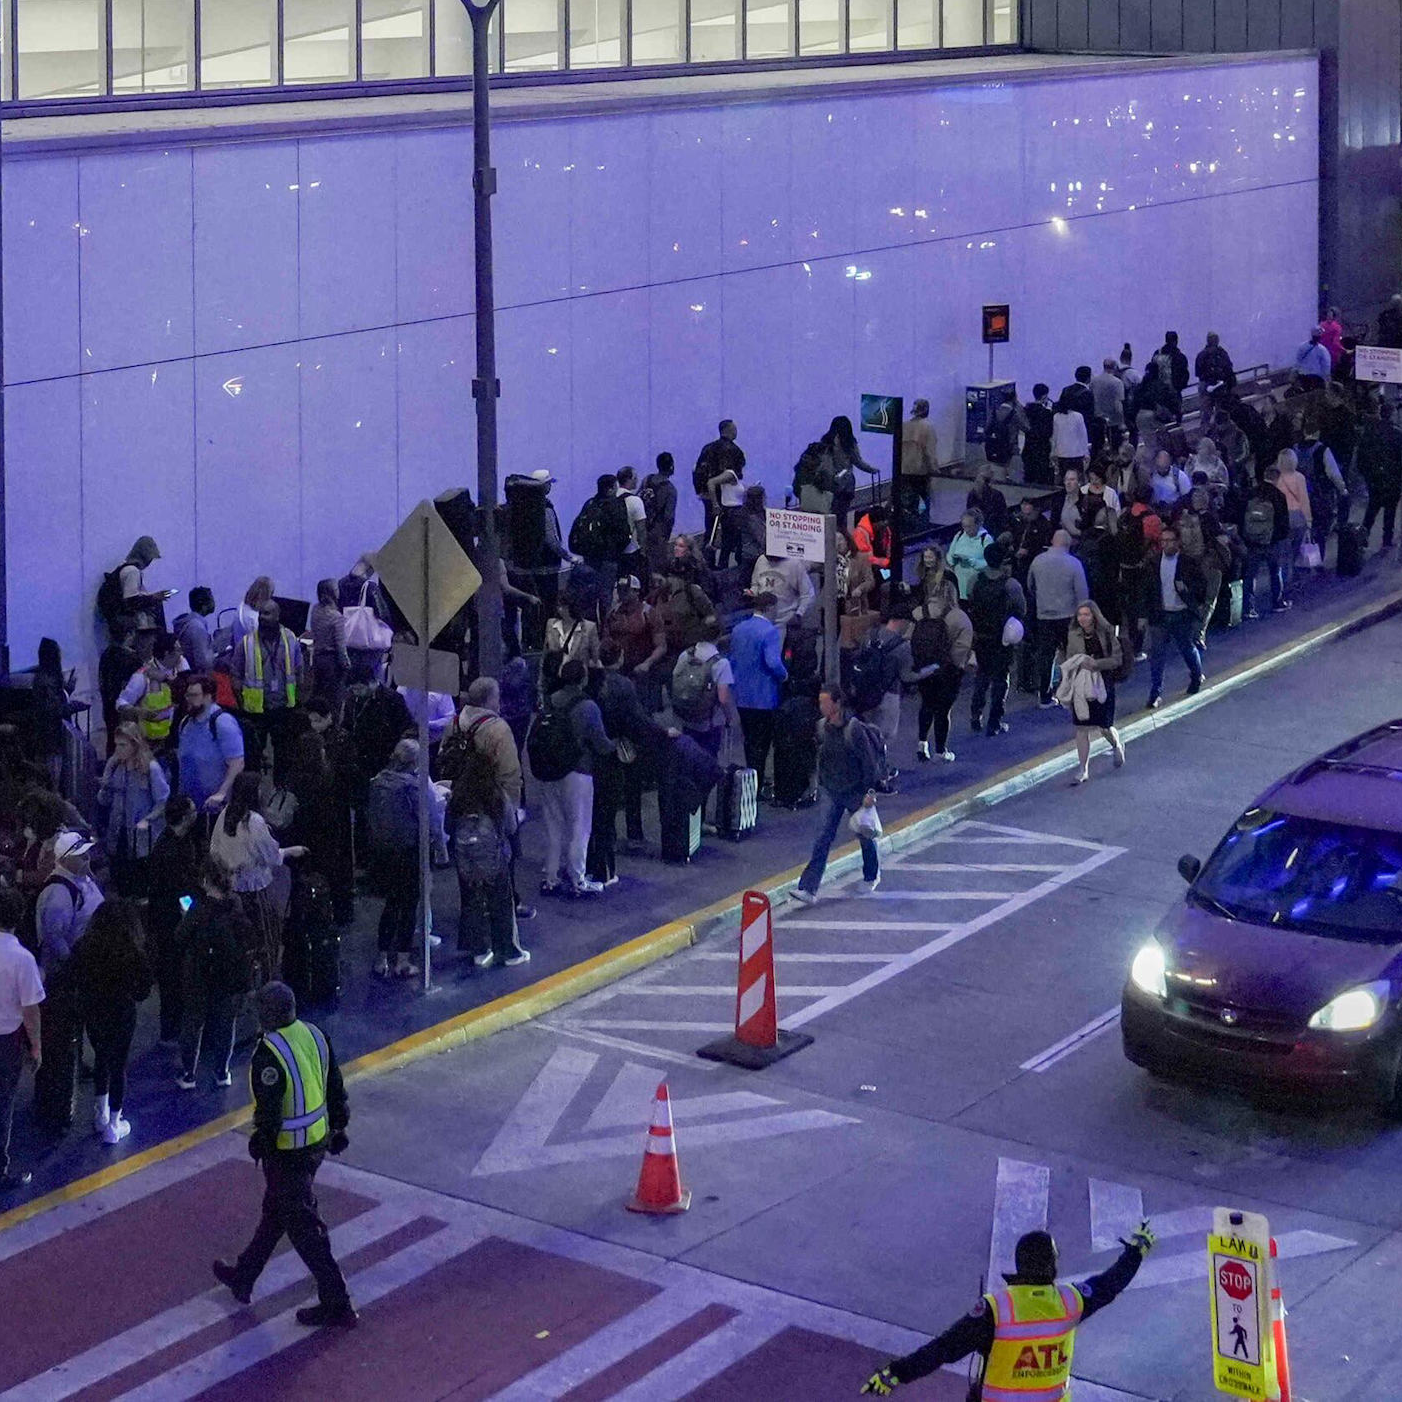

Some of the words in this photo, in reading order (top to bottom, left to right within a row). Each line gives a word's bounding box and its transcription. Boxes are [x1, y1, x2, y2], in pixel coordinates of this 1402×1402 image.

[769, 519, 780, 527] OR
[782, 521, 822, 533] STANDING
[783, 513, 821, 525] STOPPING
[1220, 1271, 1252, 1291] STOP
[1232, 1303, 1243, 1314] TO
[1013, 1342, 1068, 1369] ATL
[1227, 1366, 1252, 1382] WITHIN
